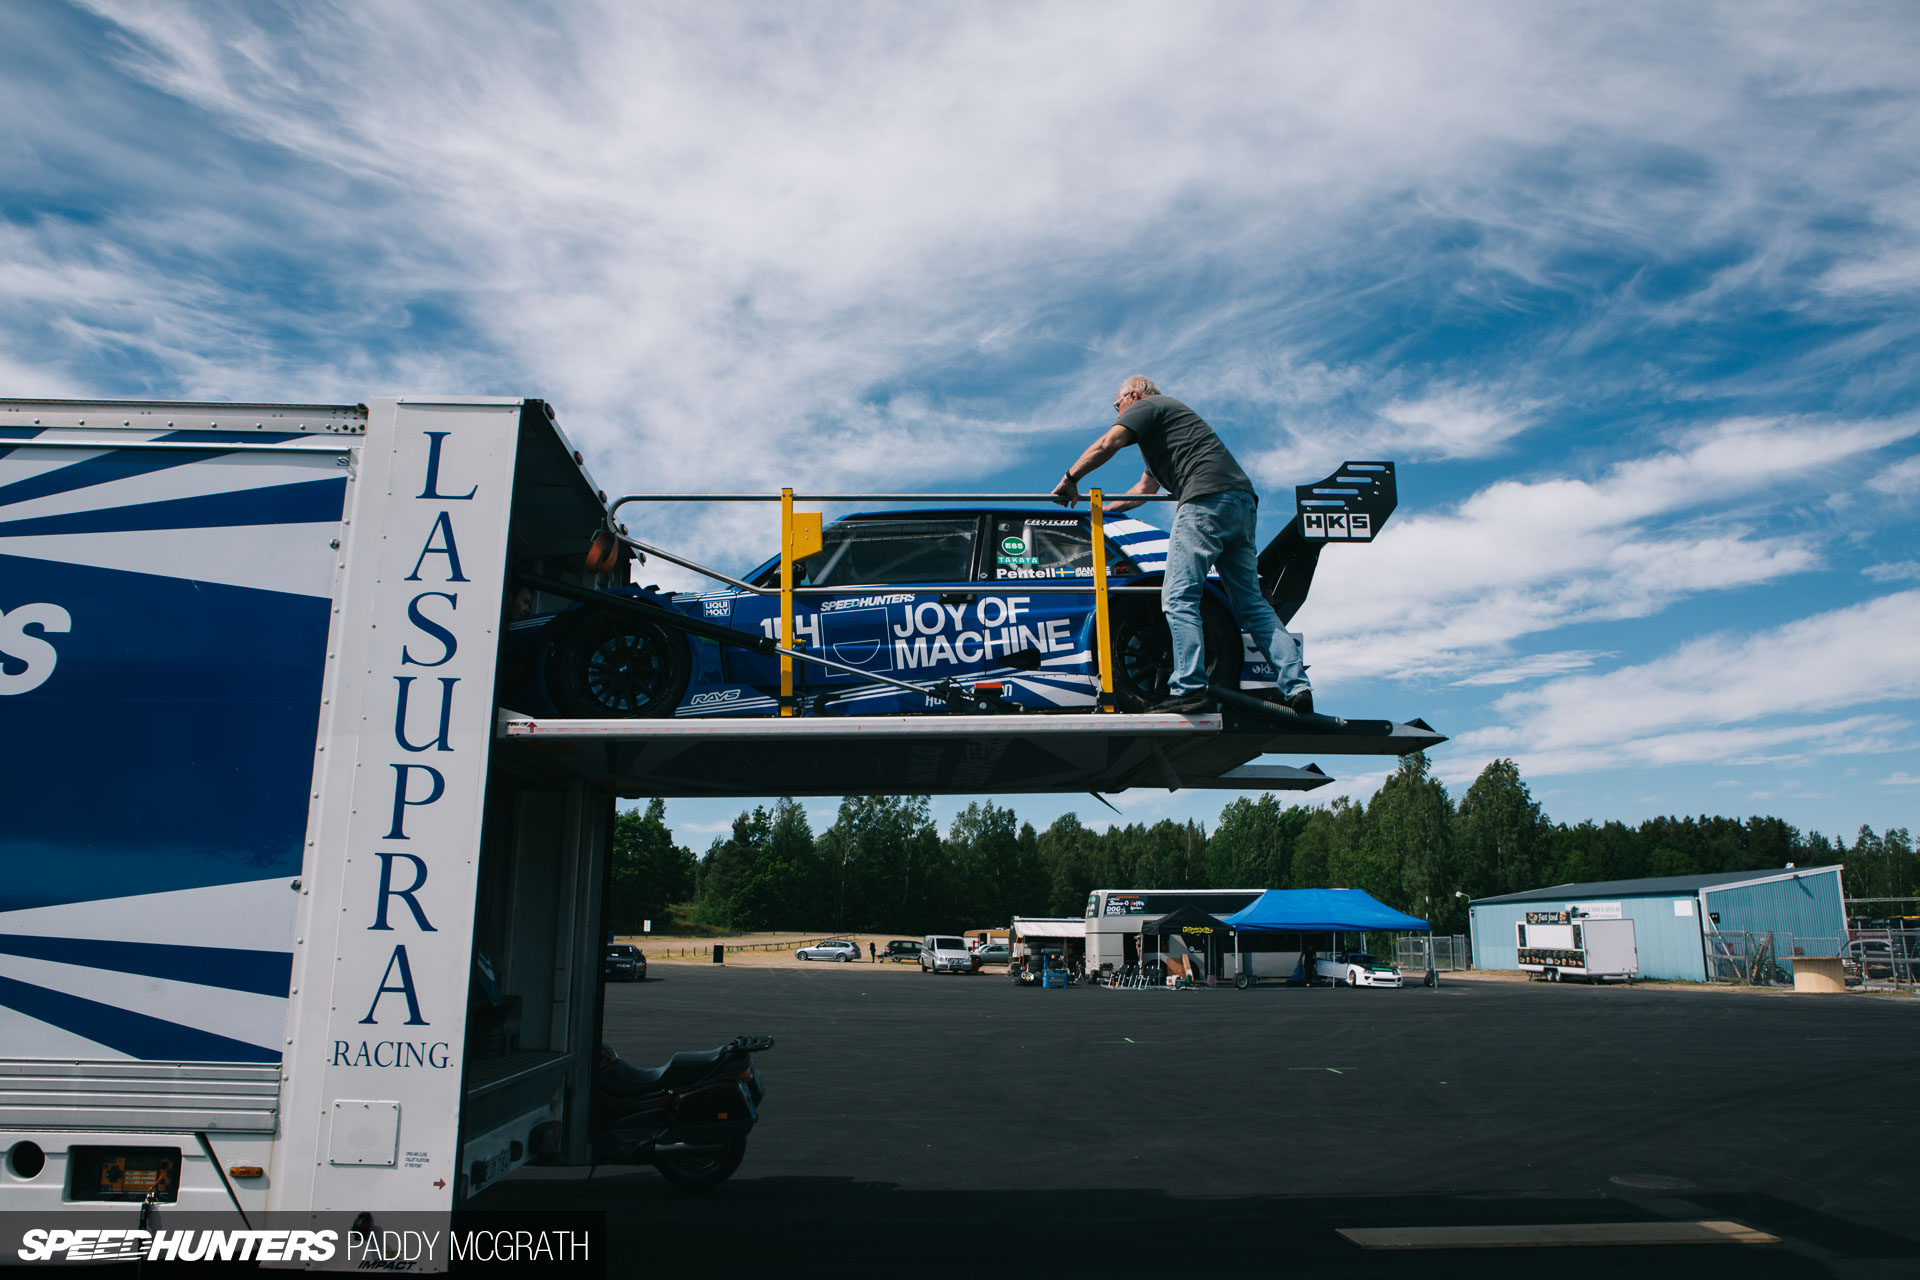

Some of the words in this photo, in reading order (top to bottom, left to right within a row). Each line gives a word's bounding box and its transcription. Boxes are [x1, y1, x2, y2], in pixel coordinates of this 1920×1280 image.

[1305, 515, 1369, 530] HKS
[996, 567, 1056, 579] Pentell
[705, 601, 728, 609] LIQUI
[820, 593, 916, 612] SPEEDHUNTERS
[705, 608, 729, 616] MOLY
[894, 602, 967, 637] JOY
[976, 597, 1031, 628] OF
[895, 618, 1075, 670] MACHINE
[691, 689, 741, 705] RAYS
[358, 1260, 417, 1270] IMPACT
